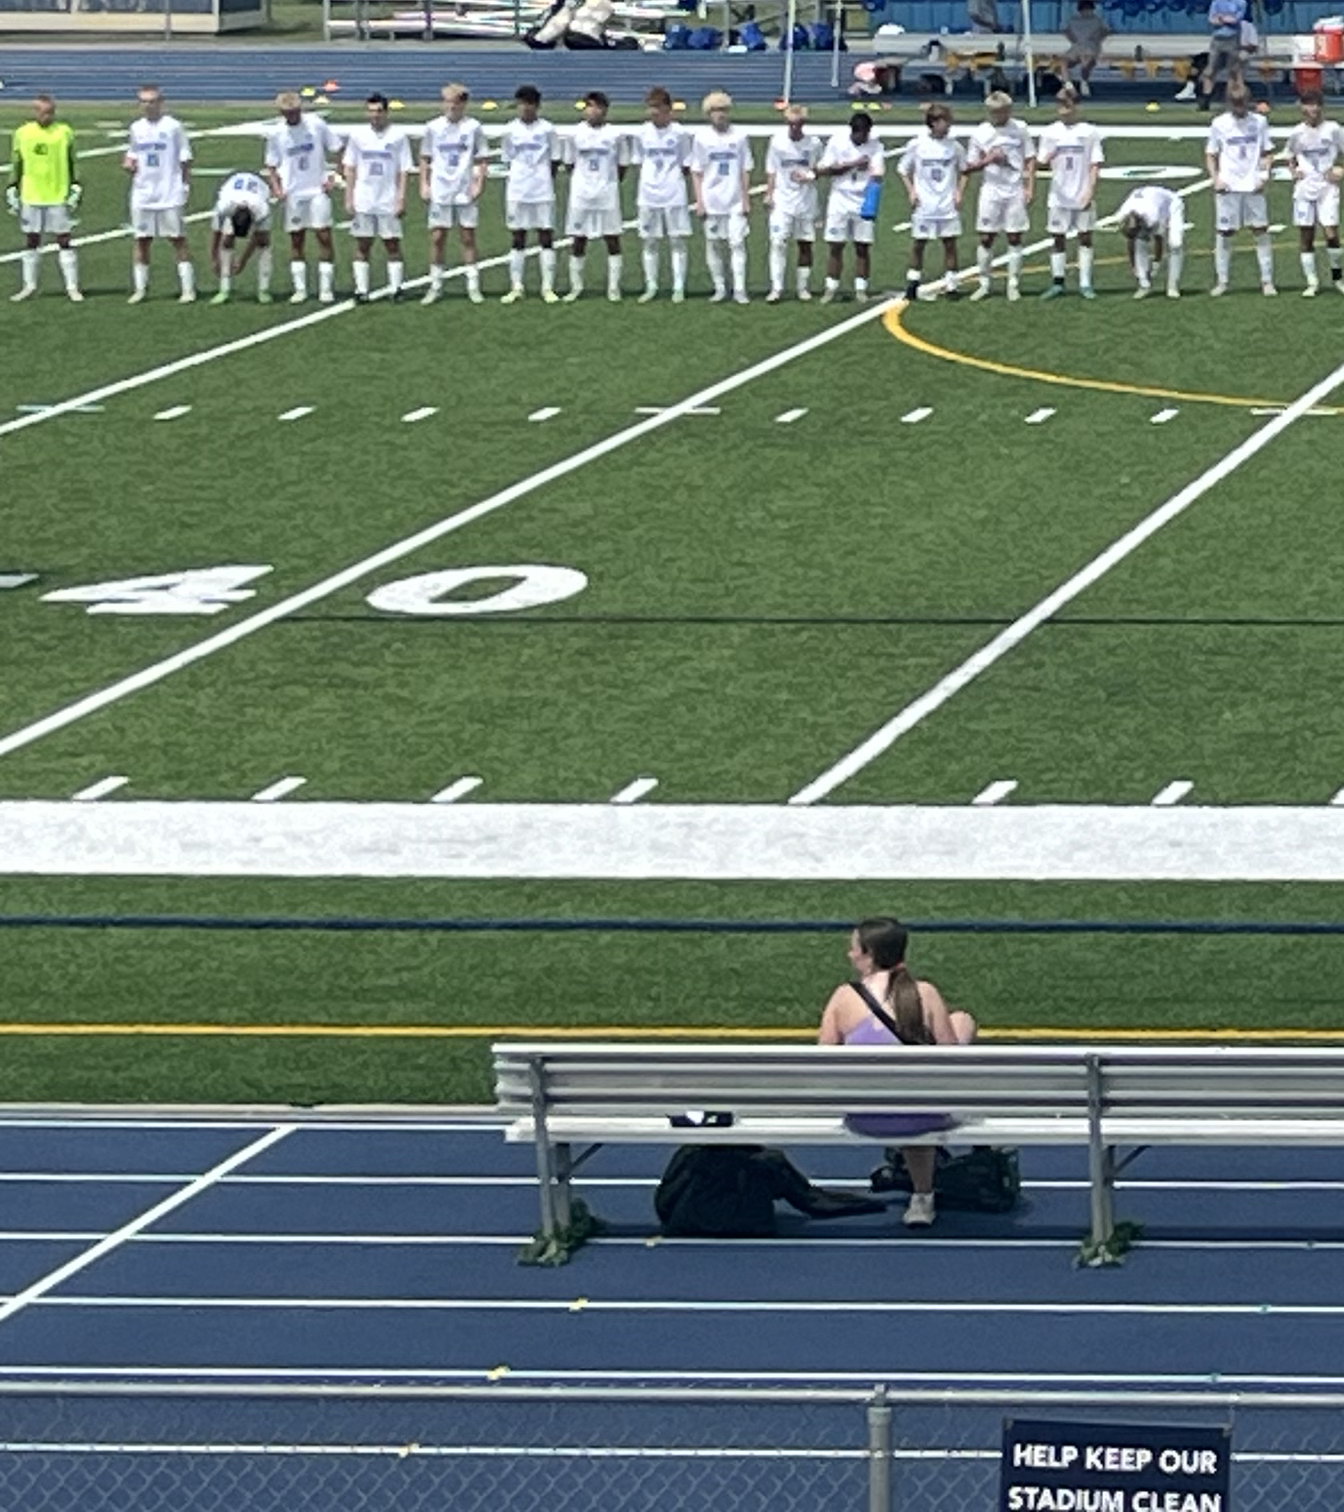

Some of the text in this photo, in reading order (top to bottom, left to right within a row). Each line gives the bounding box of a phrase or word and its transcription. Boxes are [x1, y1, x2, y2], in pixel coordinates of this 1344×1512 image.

[1013, 1443, 1218, 1475] HELP KEEP OUR
[1007, 1485, 1222, 1512] STADIUM CLEAN
